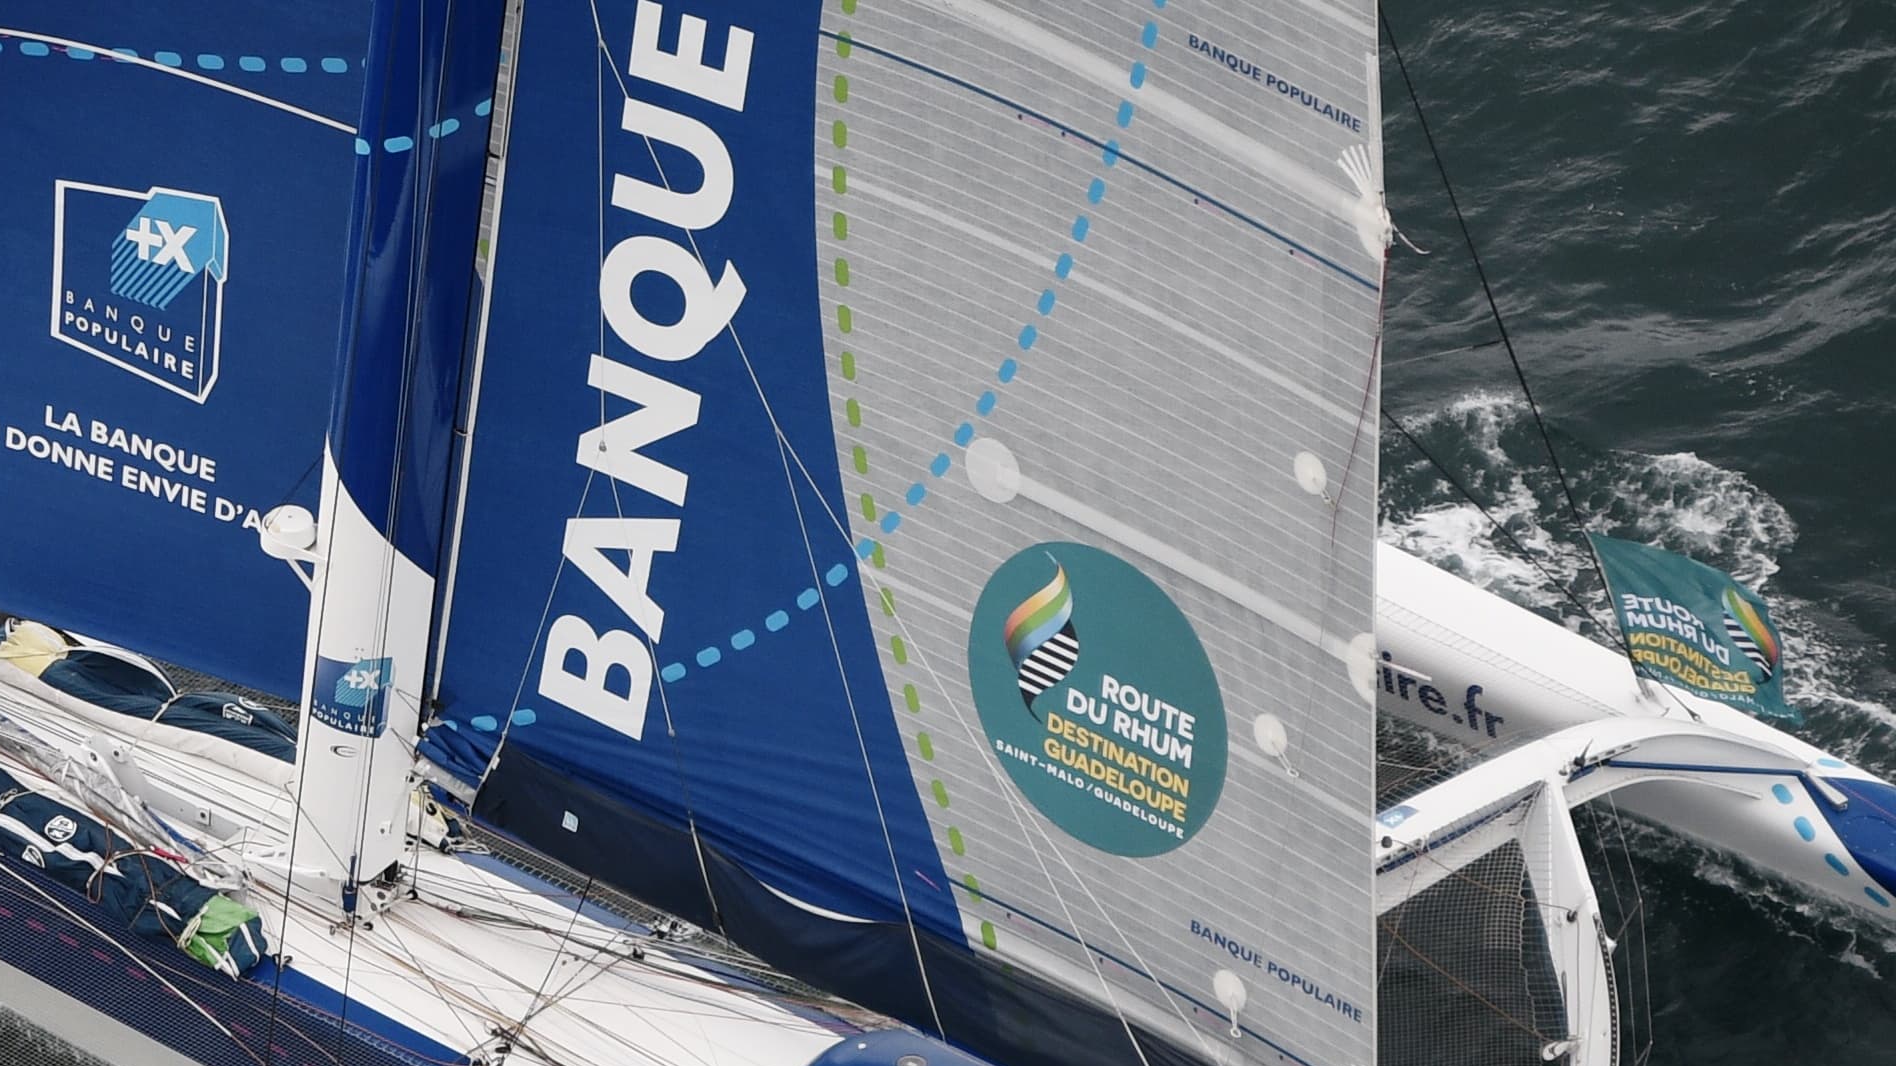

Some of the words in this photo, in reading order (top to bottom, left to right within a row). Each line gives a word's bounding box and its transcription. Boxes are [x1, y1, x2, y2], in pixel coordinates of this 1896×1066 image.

[1189, 34, 1262, 82] BANQUE
[1266, 73, 1362, 133] POPULAIRE
[64, 311, 196, 380] POPULAIRE
[65, 290, 196, 353] BANQUE
[538, 0, 755, 742] BANQUE
[5, 426, 114, 482] DONNE
[121, 464, 207, 514] ENVIE
[44, 404, 83, 438] LA
[90, 420, 216, 483] BANQUE
[311, 707, 375, 735] POPULAIRE
[1066, 687, 1108, 725] DU
[1112, 710, 1193, 770] RHUM
[1101, 674, 1196, 741] ROUTE
[1377, 651, 1504, 738] ire.fr
[1043, 737, 1188, 823] GUADELOUPE
[1047, 711, 1191, 798] DESTINATION
[1190, 919, 1263, 969] BANQUE
[1267, 960, 1363, 1024] POPULAIRE
